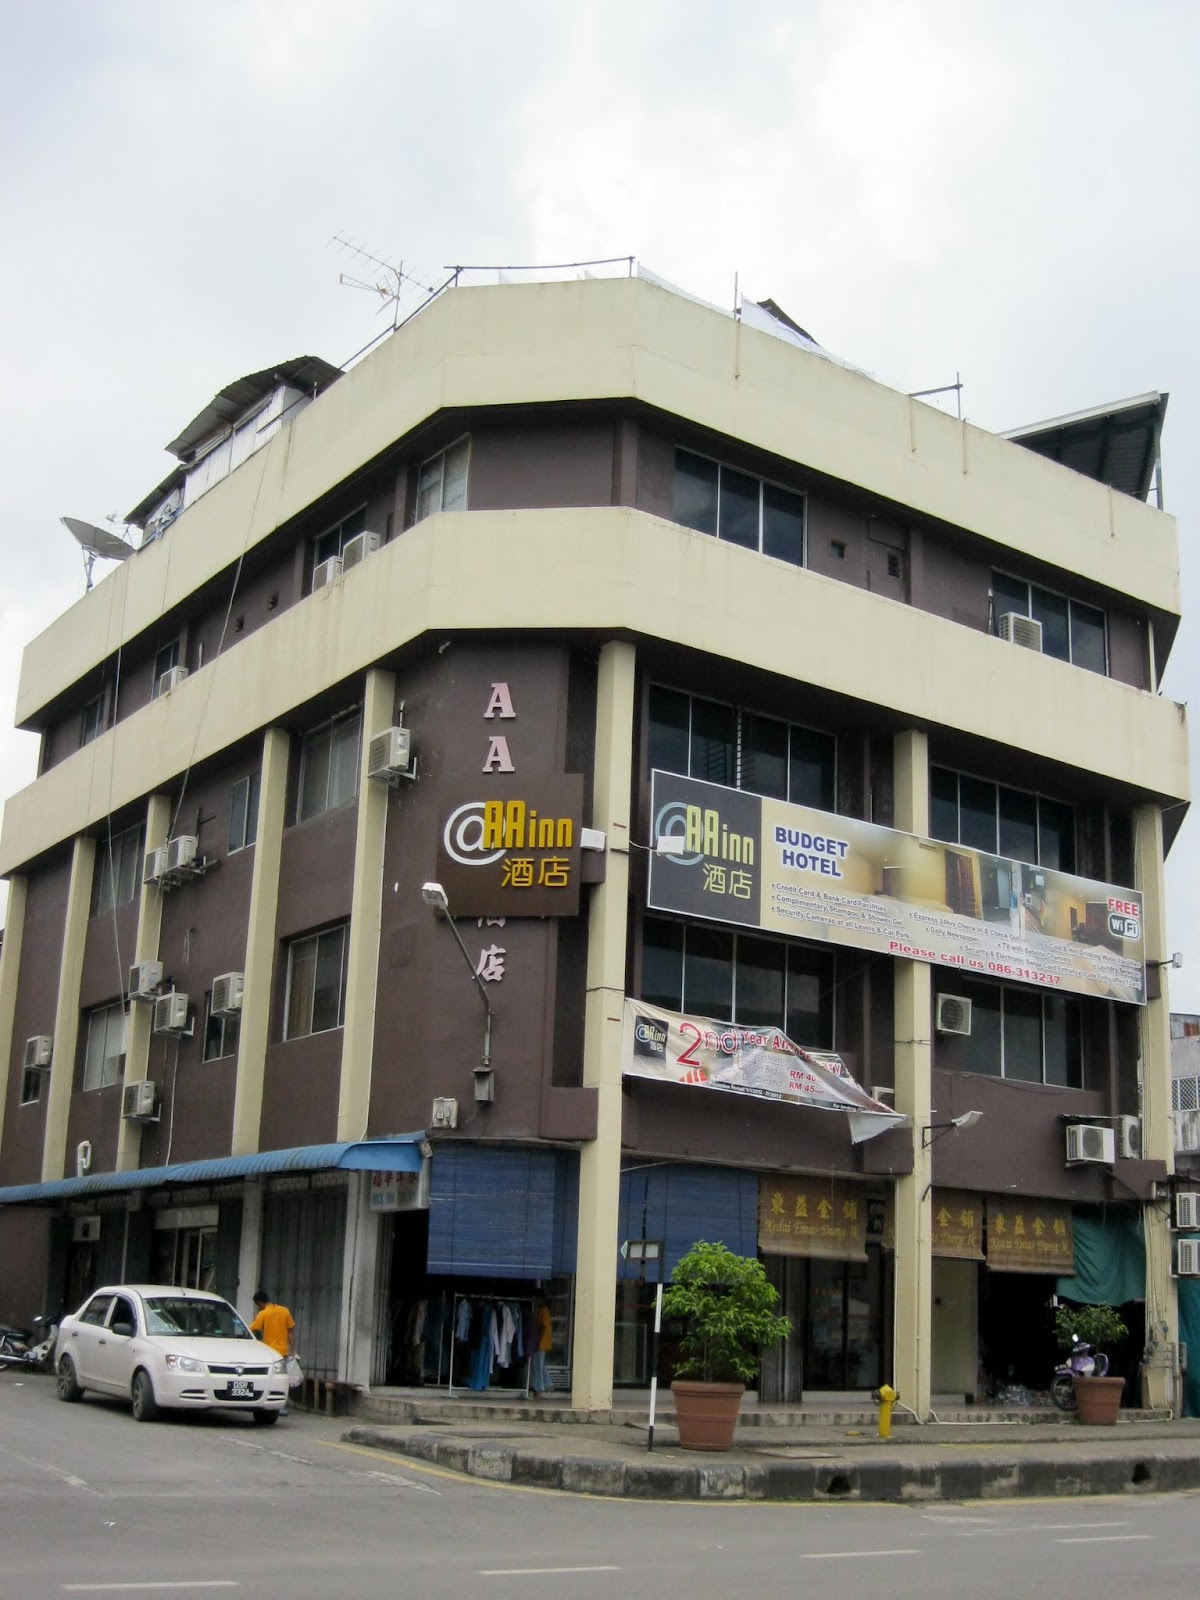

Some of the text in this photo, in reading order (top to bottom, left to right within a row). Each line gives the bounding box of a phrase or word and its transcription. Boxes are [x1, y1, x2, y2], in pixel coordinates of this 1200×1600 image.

[775, 826, 848, 858] BUDGET
[501, 856, 571, 888] 酒店
[782, 849, 842, 878] HOTEL
[702, 862, 753, 900] 酒店
[776, 883, 798, 893] Credit
[798, 888, 815, 897] Card
[823, 893, 840, 902] Bank
[842, 897, 857, 906] Card
[858, 901, 887, 912] Facilities
[776, 894, 828, 912] Complimentary
[829, 906, 859, 917] Shampoo
[868, 914, 891, 924] Shower
[892, 918, 903, 926] Gel
[1107, 898, 1139, 917] FREE
[776, 906, 805, 919] Security
[806, 912, 835, 924] Cameras
[854, 922, 875, 933] Levels
[883, 928, 894, 936] Car
[913, 913, 938, 924] Express
[939, 918, 956, 927] 24hrs
[957, 922, 976, 932] Check
[990, 930, 1008, 938] Check
[1009, 934, 1020, 942] Out
[930, 927, 979, 944] Daily Newspaper
[890, 941, 1061, 984] Please call us 086-313237
[964, 945, 989, 956] Security
[996, 952, 1024, 966] Electronic
[1025, 959, 1042, 968] Swipe
[1044, 963, 1057, 971] Card
[1058, 966, 1081, 976] Entrance
[1011, 945, 1023, 953] with
[1047, 952, 1072, 963] Channels
[1049, 943, 1062, 951] Cold
[1079, 949, 1101, 960] Drinking
[1097, 963, 1141, 978] Laundry Services
[676, 1022, 738, 1067] 2nd
[741, 1030, 769, 1046] Year
[789, 1070, 804, 1080] RM
[789, 1081, 802, 1090] RM
